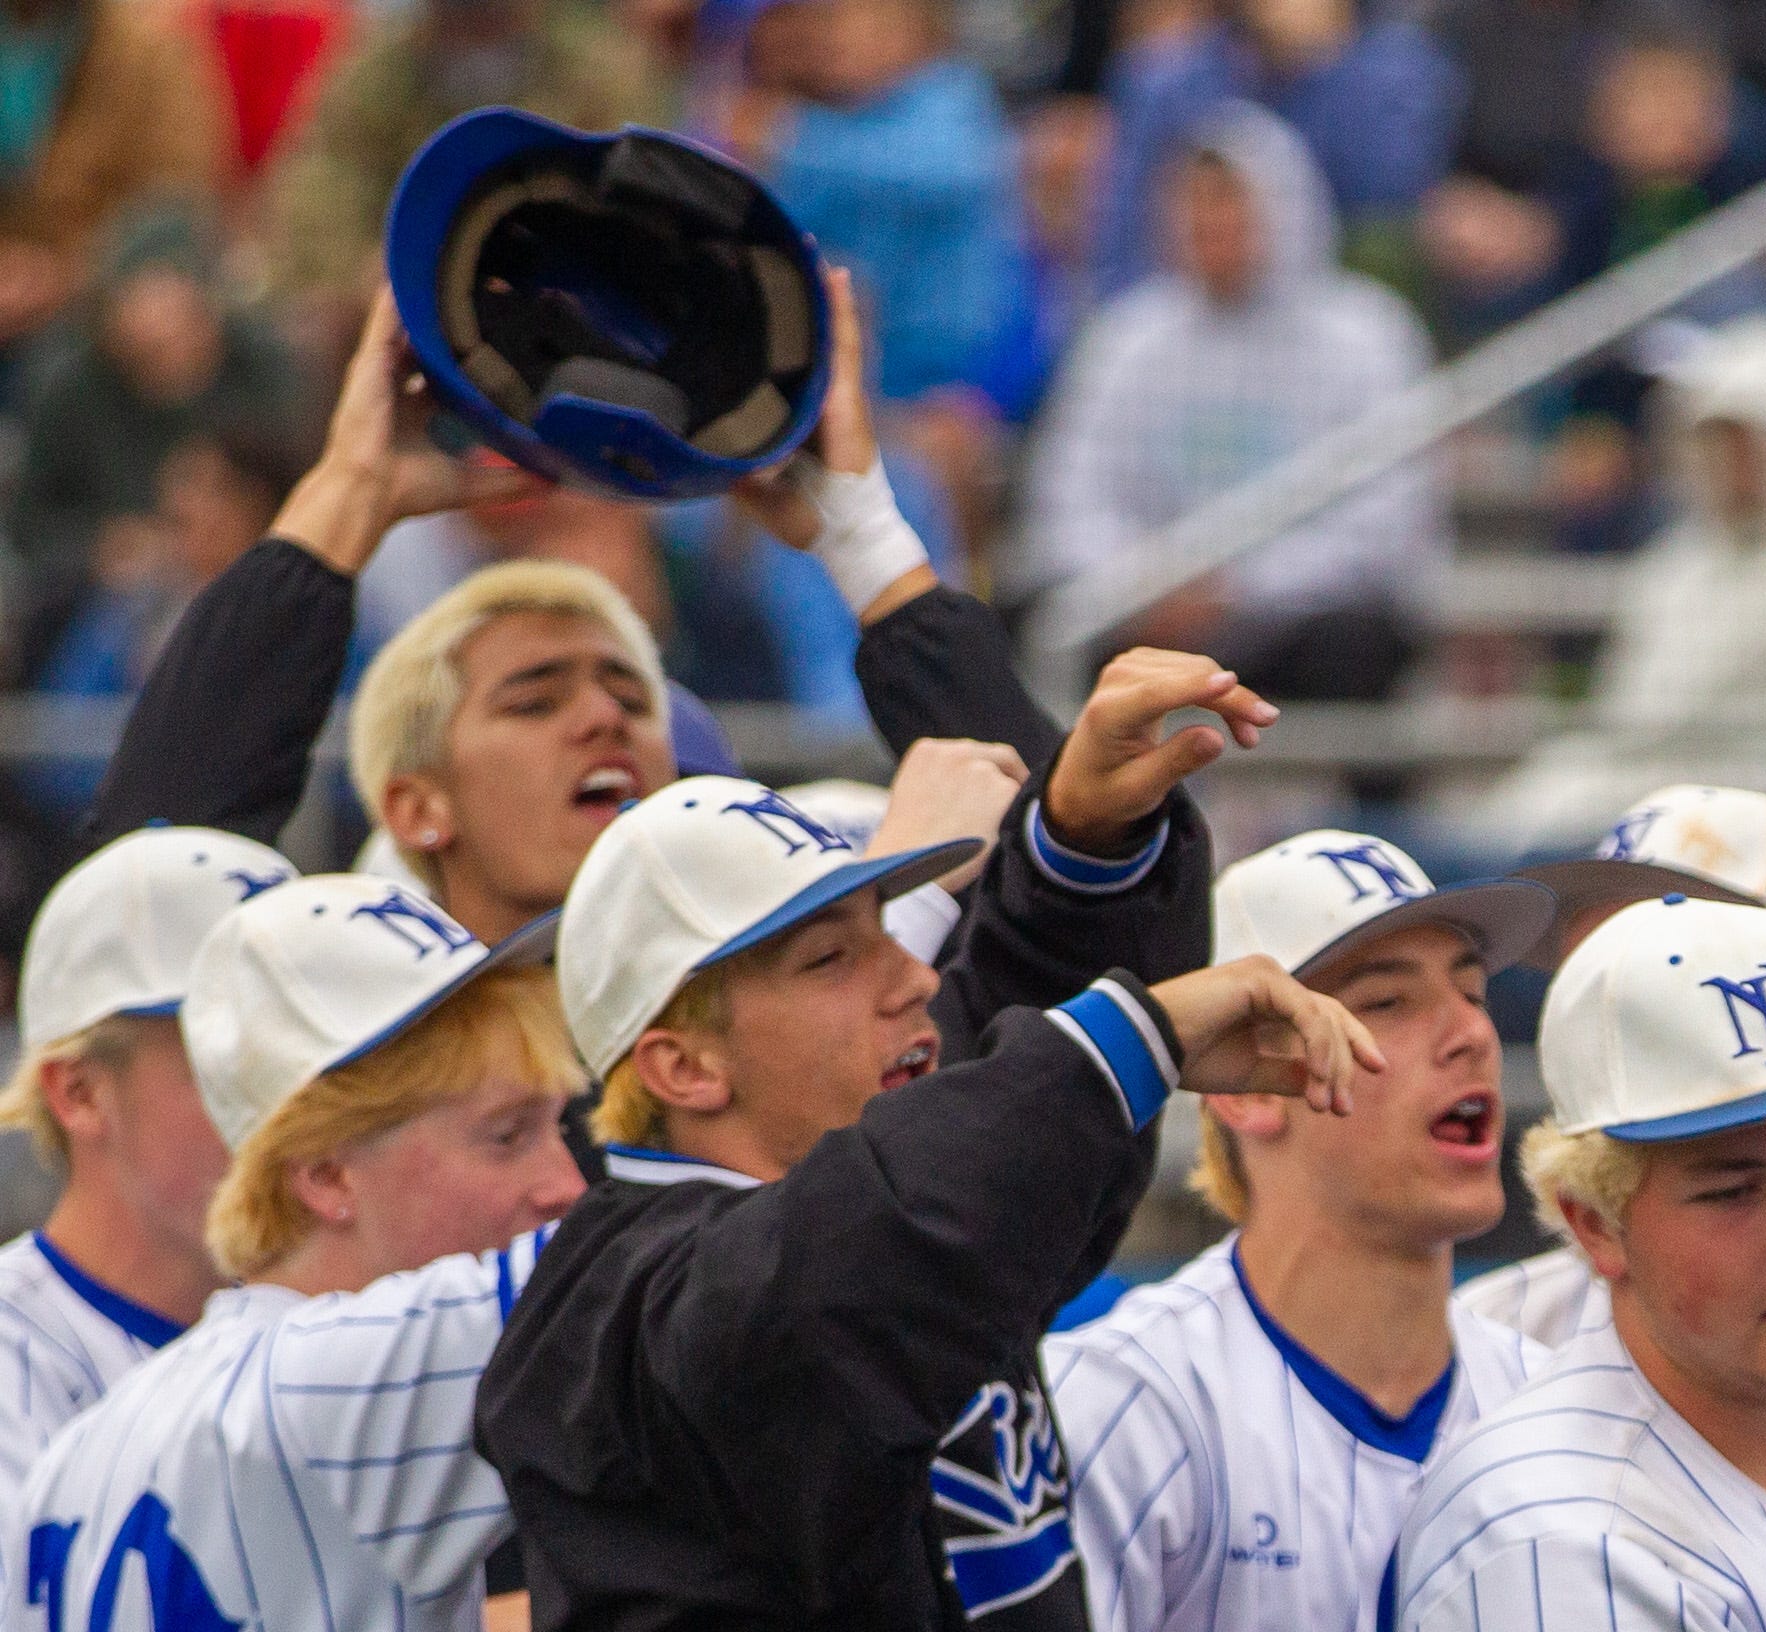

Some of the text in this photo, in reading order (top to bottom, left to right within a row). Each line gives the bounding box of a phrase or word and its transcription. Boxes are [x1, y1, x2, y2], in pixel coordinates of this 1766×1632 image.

[721, 788, 853, 857] NL
[1309, 841, 1436, 902] NL
[350, 884, 476, 958] NL
